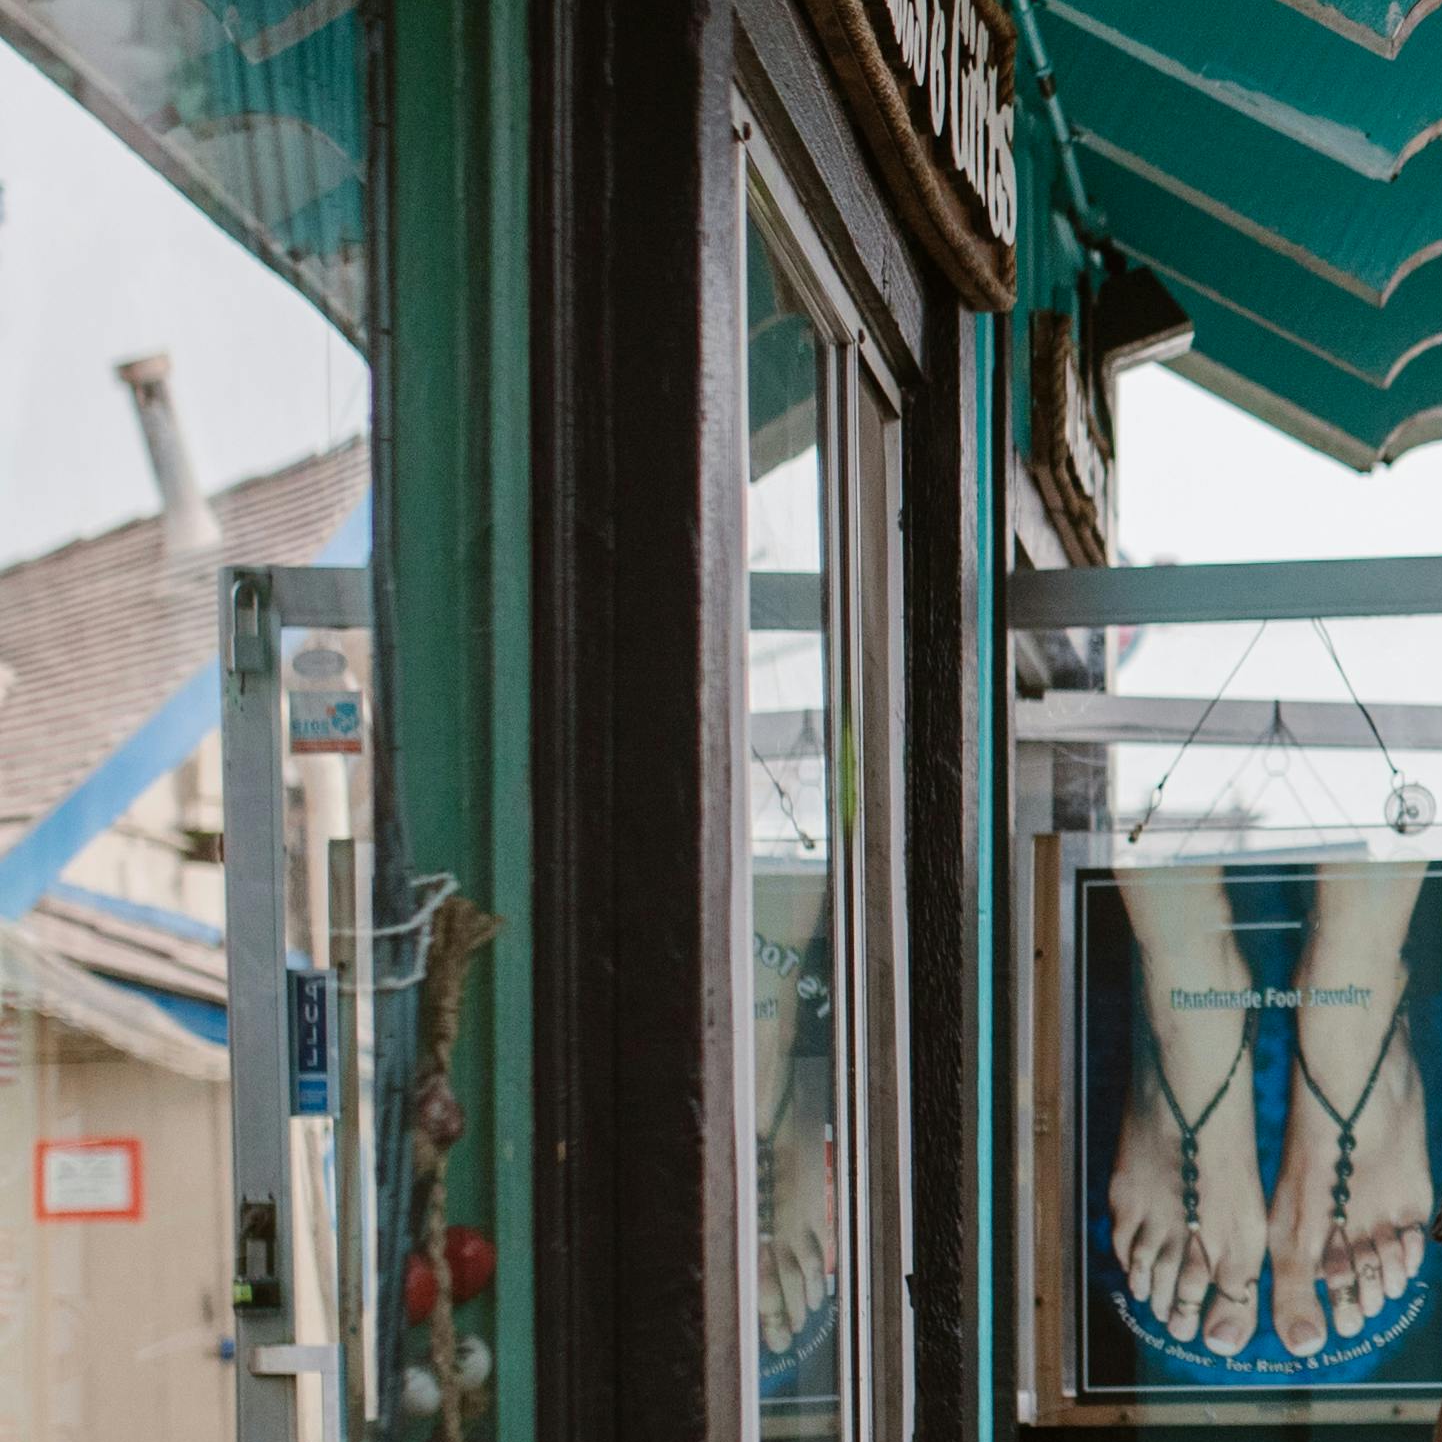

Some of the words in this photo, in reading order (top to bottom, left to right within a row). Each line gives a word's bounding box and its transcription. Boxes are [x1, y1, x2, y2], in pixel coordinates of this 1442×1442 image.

[1171, 987, 1262, 1009] Handmade
[1264, 986, 1302, 1009] Foot
[1308, 984, 1372, 1010] Jewelry
[1226, 1356, 1253, 1372] Toe
[1256, 1358, 1304, 1375] Rings
[1306, 1356, 1319, 1370] &
[1321, 1339, 1373, 1367] Island
